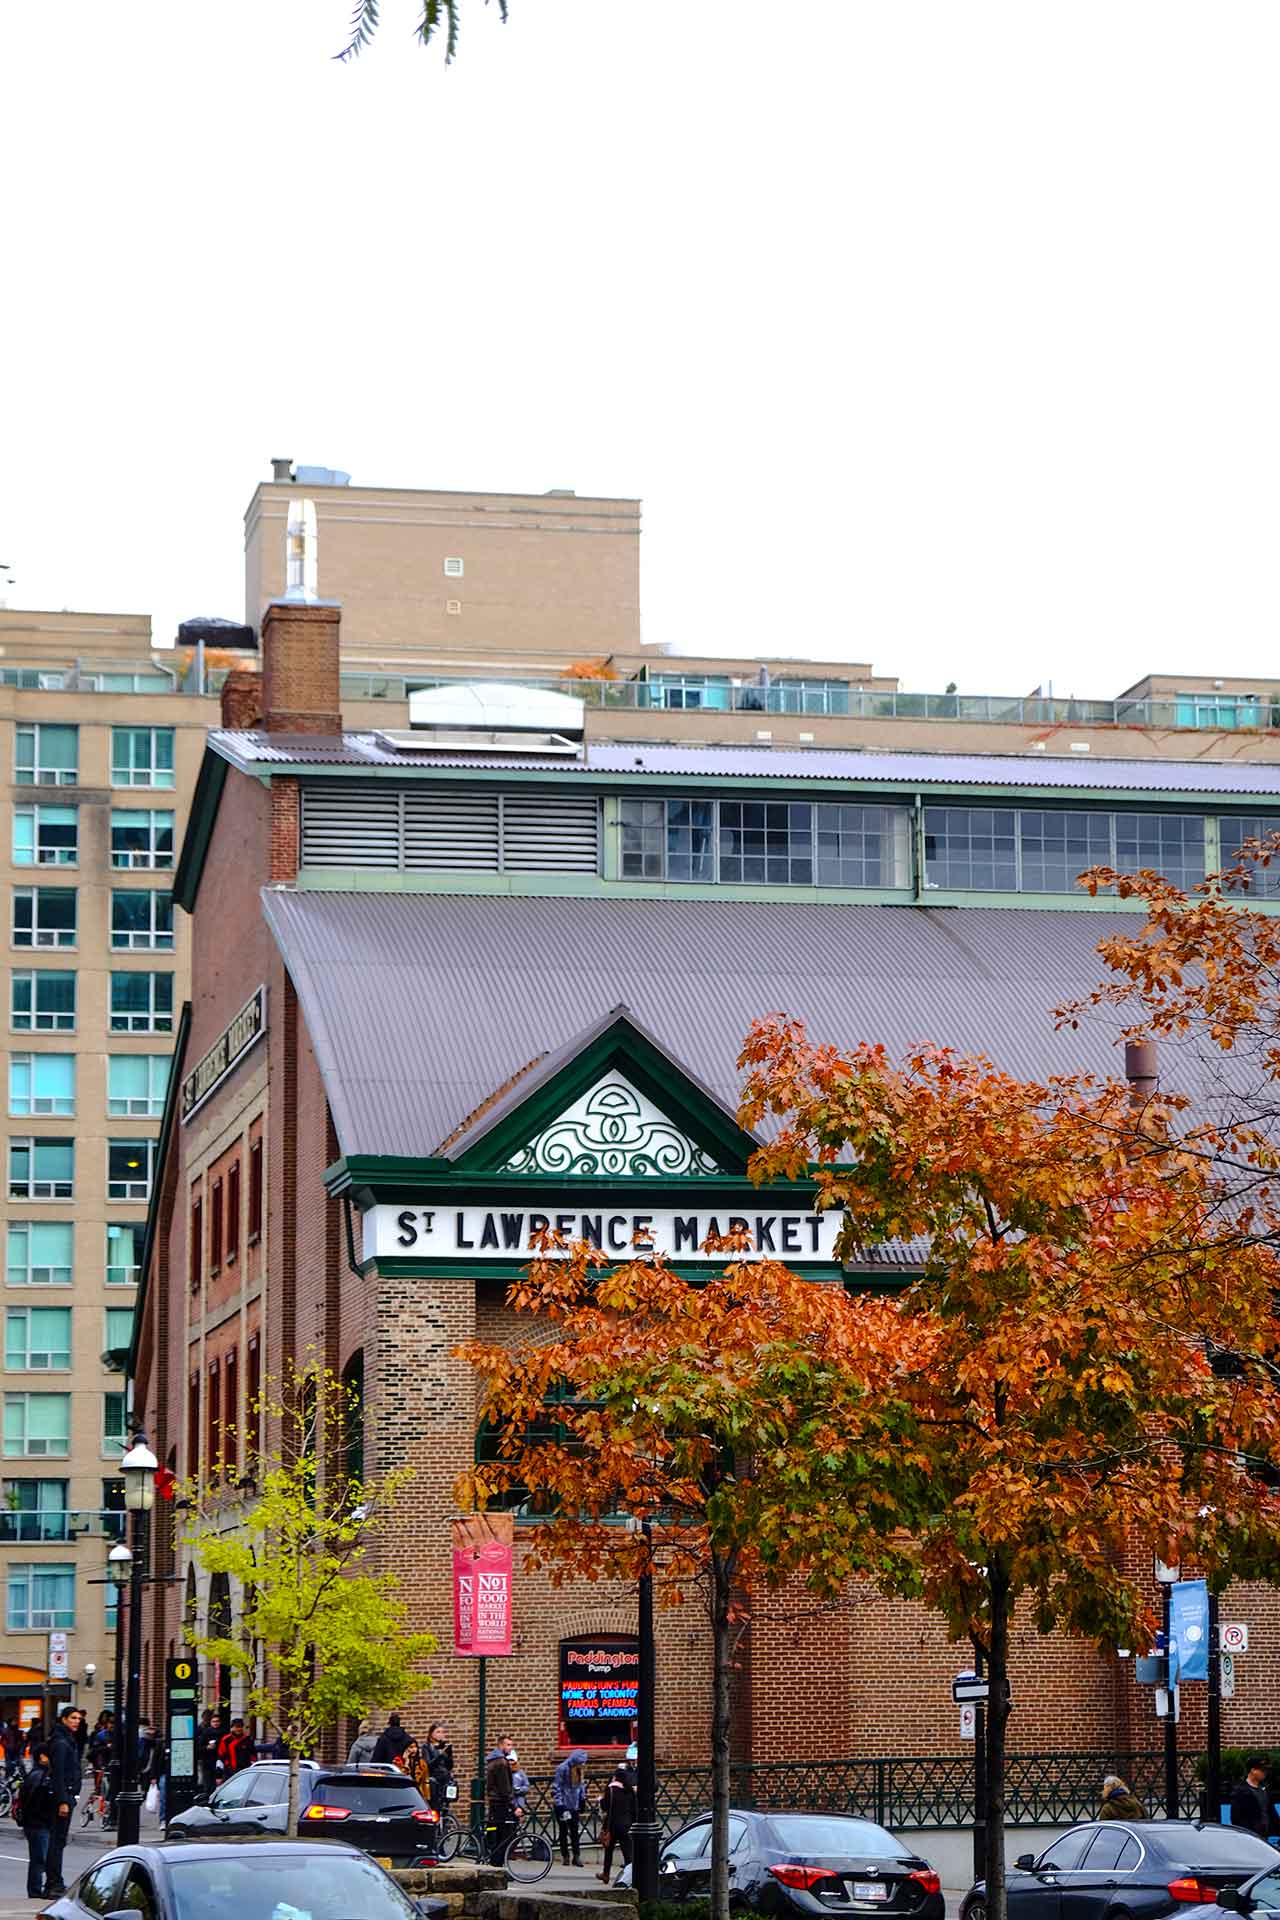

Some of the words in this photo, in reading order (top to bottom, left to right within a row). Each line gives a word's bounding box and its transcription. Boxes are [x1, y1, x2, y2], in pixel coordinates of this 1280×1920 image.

[478, 1593, 508, 1603] FOOD
[567, 1650, 639, 1668] Paddington
[588, 1664, 612, 1674] Pump
[562, 1690, 584, 1699] HOME
[586, 1690, 597, 1699] OF
[568, 1699, 599, 1708] FAMOUS
[568, 1708, 595, 1717] BACON
[598, 1707, 638, 1717] SANDWICH
